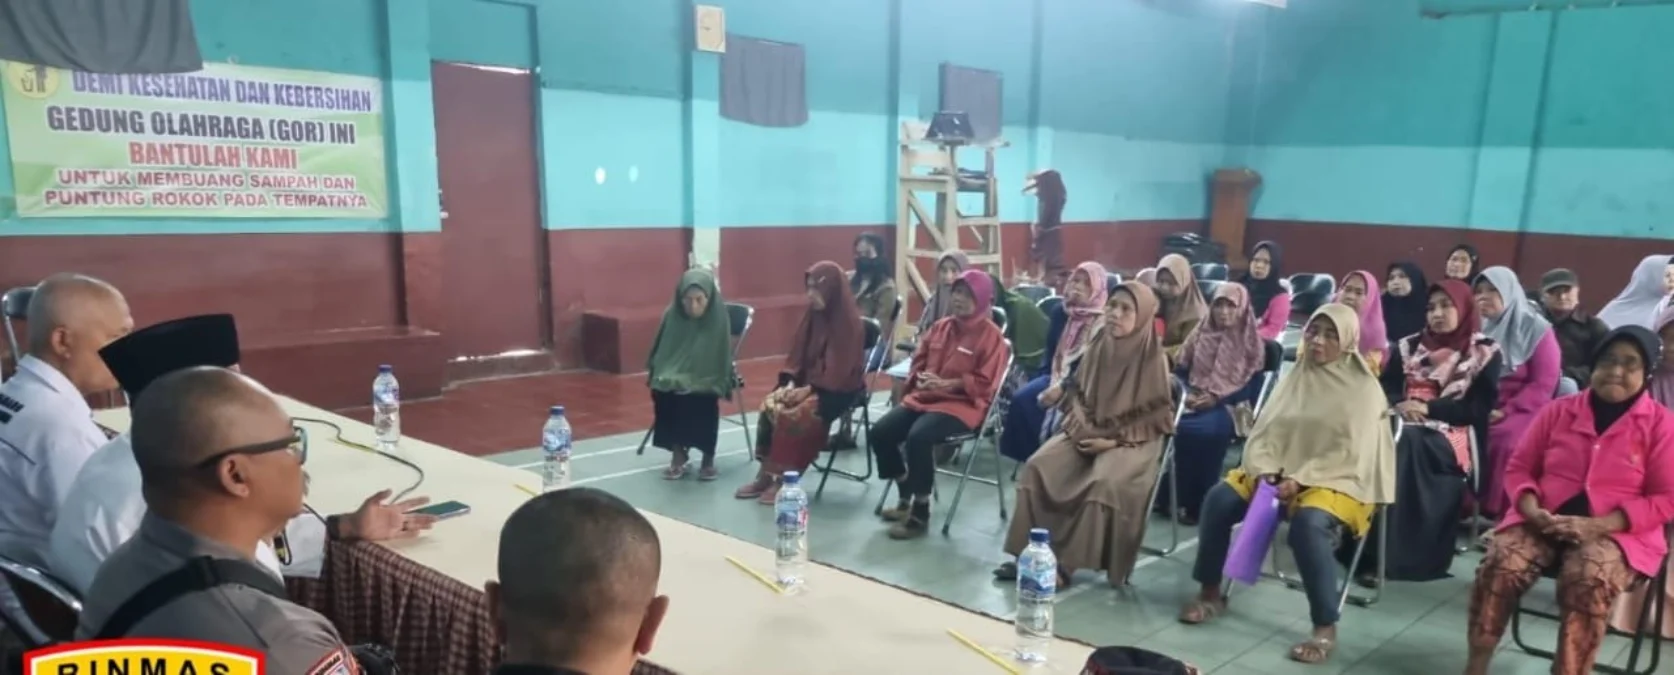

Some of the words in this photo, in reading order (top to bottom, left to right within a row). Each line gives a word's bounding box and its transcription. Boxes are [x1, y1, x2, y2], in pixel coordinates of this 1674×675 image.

[73, 70, 122, 94] DEMI
[128, 73, 231, 102] KESEHATAN
[235, 80, 269, 105] DAN
[274, 83, 371, 112] KEBERSIHAN
[47, 106, 145, 133] GEDUNG
[150, 111, 264, 140] OLAHRAGA
[269, 118, 325, 143] (GOR)
[330, 122, 356, 145] INI
[129, 142, 241, 168] BANTULAH
[246, 146, 297, 169] KAMI
[58, 169, 131, 186] UNTUK
[137, 171, 245, 188] MEMBUANG
[250, 174, 318, 189] SAMPAH
[323, 177, 355, 190] DAN
[45, 190, 145, 206] PUNTUNG
[152, 192, 218, 207] ROKOK
[224, 193, 268, 207] PADA
[273, 194, 367, 208] TEMPATNYA
